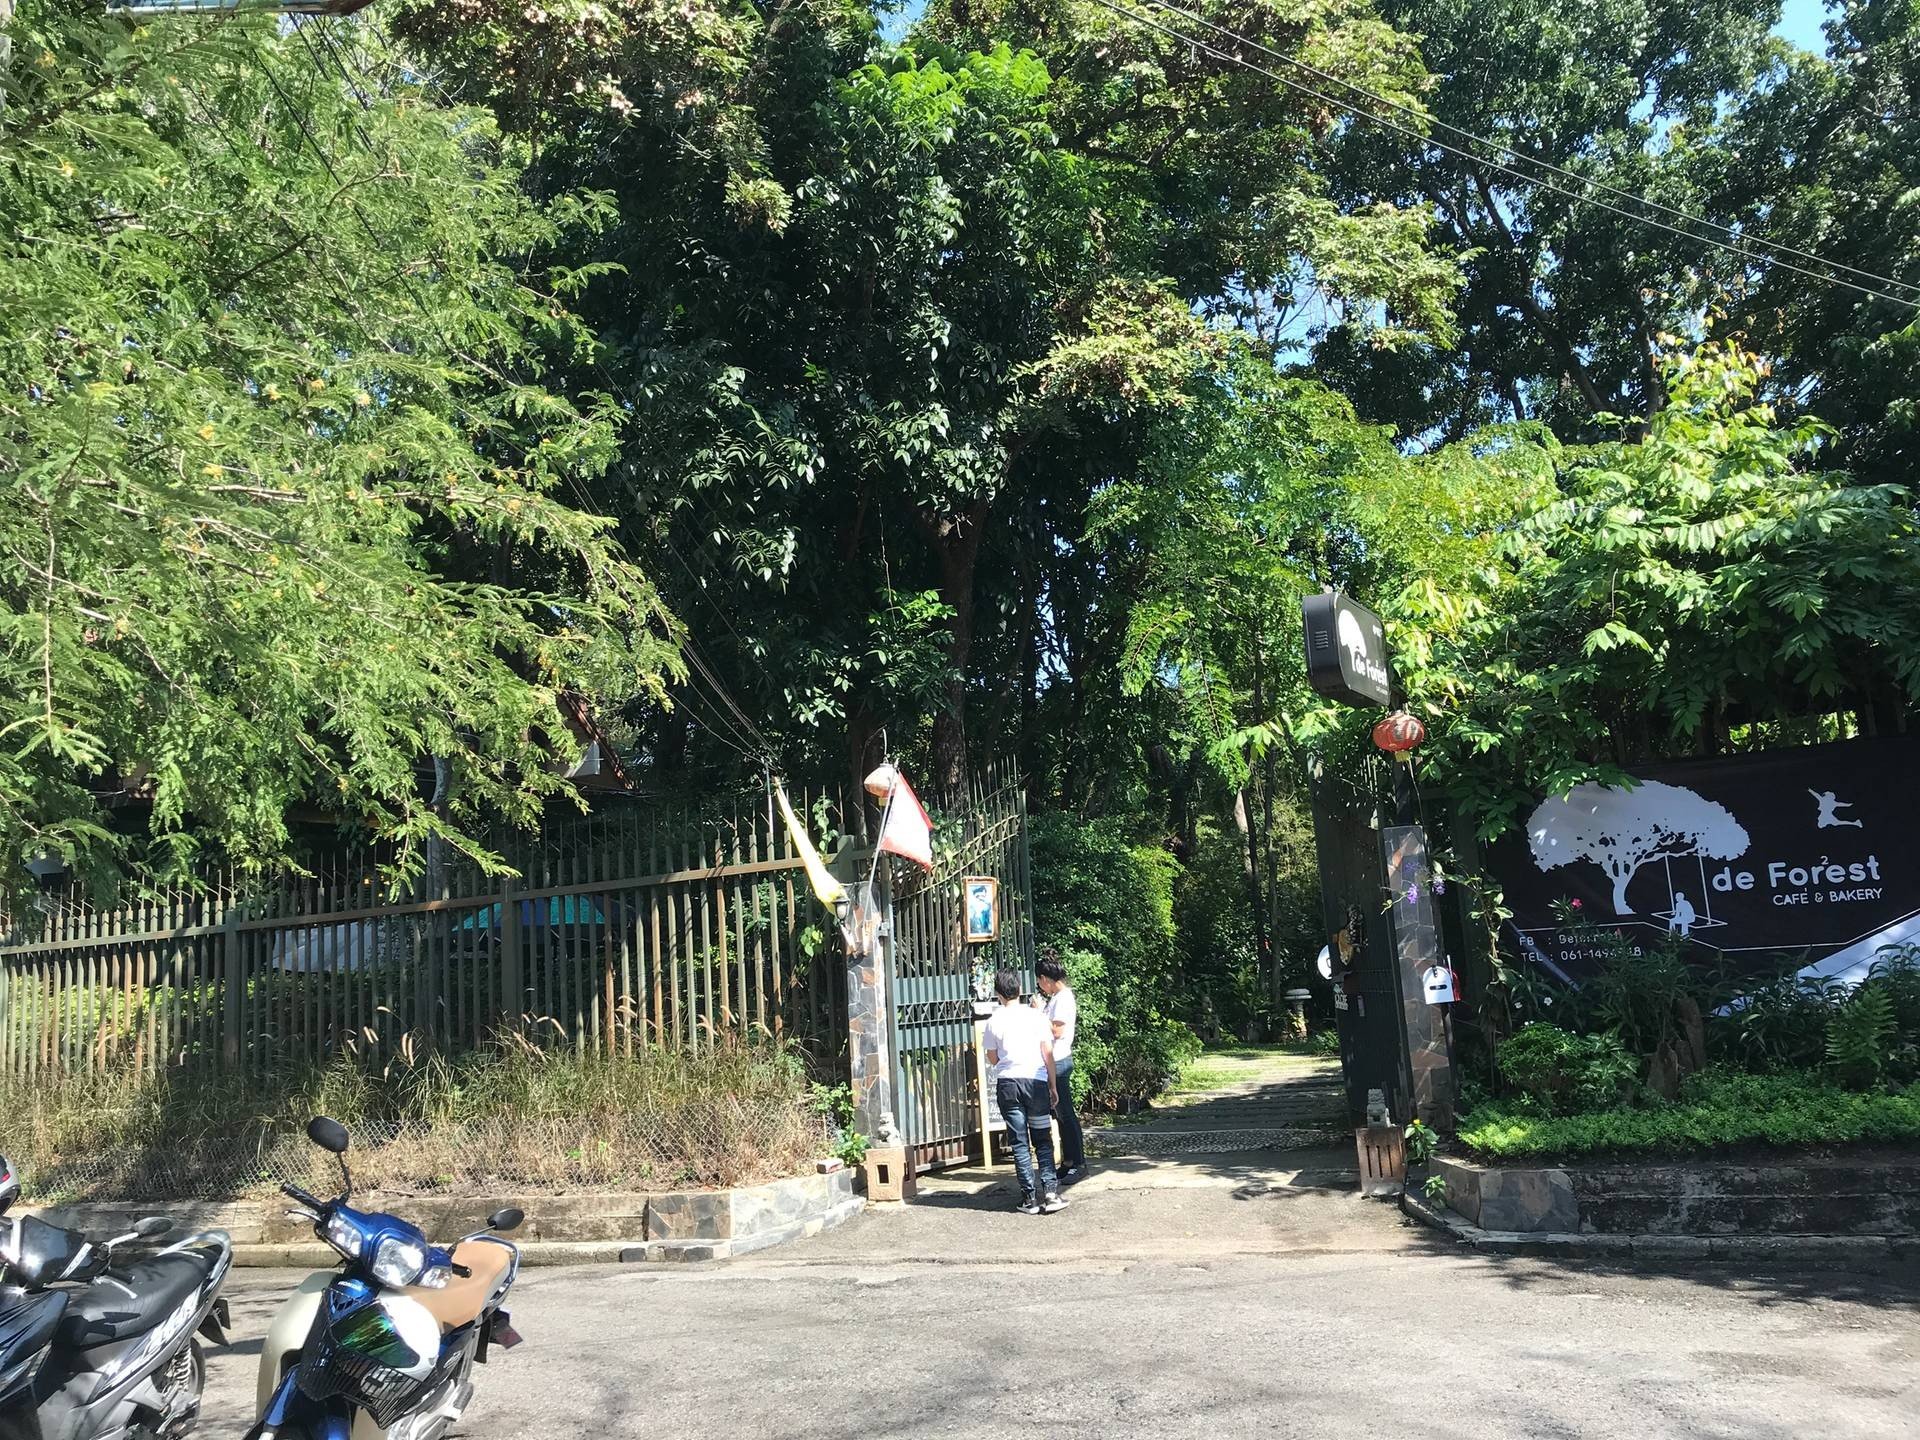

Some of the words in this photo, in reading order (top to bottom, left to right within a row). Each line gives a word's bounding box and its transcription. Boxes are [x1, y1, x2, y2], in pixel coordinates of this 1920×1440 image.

[1711, 866, 1756, 893] de
[1814, 892, 1824, 904] &
[1829, 887, 1883, 904] BAKERY
[1519, 936, 1535, 947] FB
[1520, 952, 1544, 963] TEL
